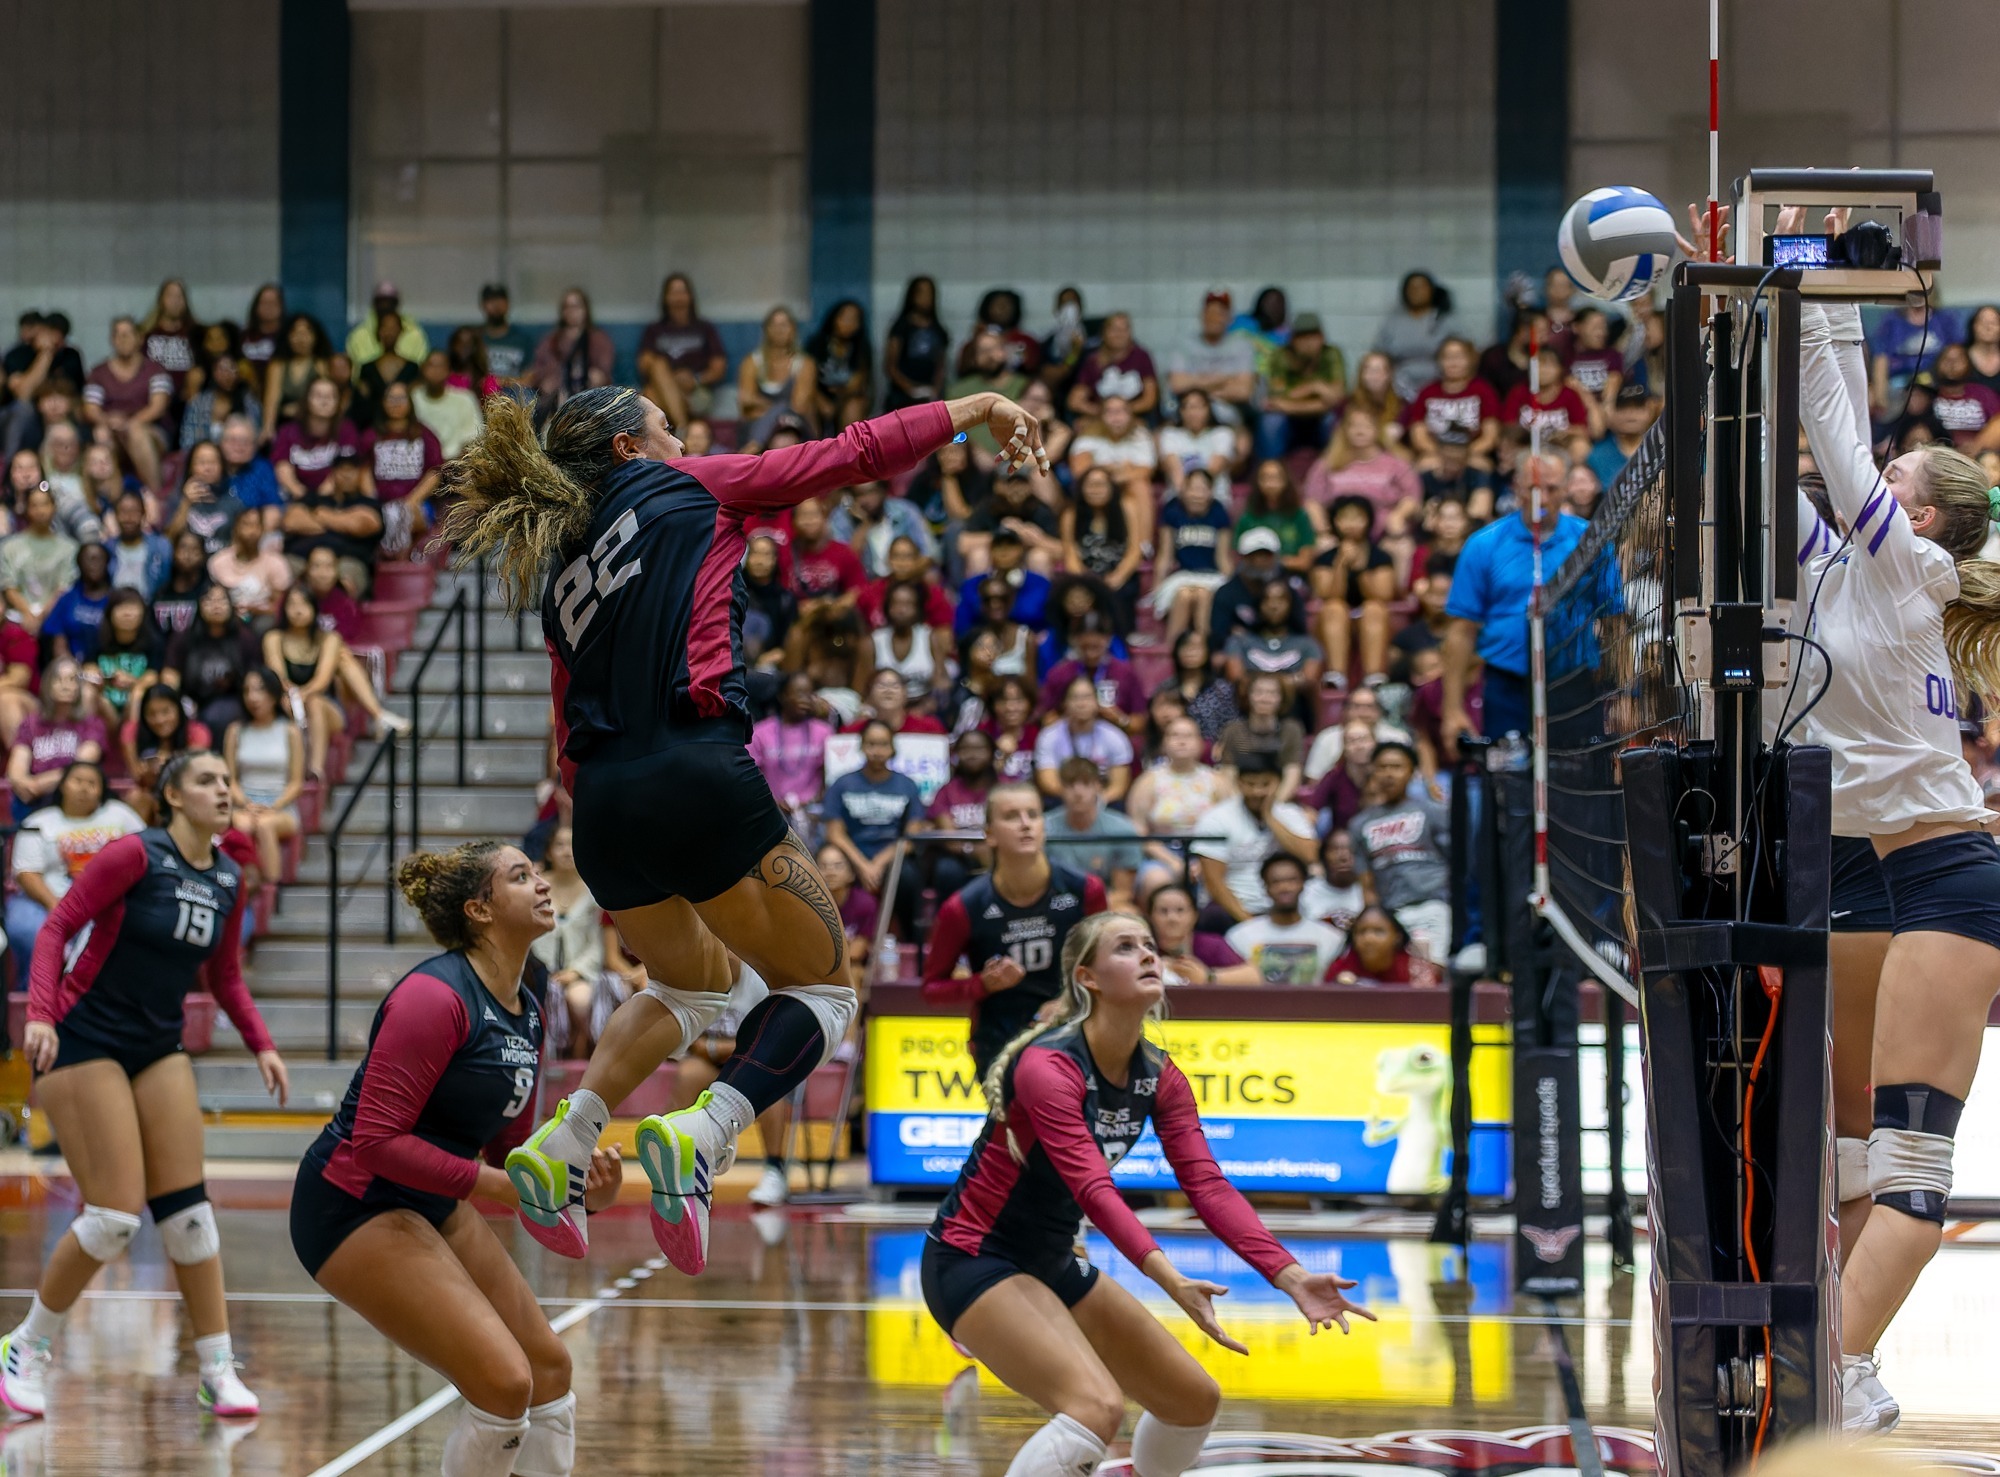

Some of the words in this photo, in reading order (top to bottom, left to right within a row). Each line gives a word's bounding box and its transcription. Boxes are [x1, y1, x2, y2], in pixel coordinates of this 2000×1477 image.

[554, 508, 643, 652] 22
[173, 901, 215, 948] 19
[1008, 939, 1053, 971] 10
[1213, 1040, 1250, 1060] OF
[502, 1067, 534, 1118] 9
[903, 1070, 979, 1099] TW
[1193, 1073, 1296, 1104] TICS
